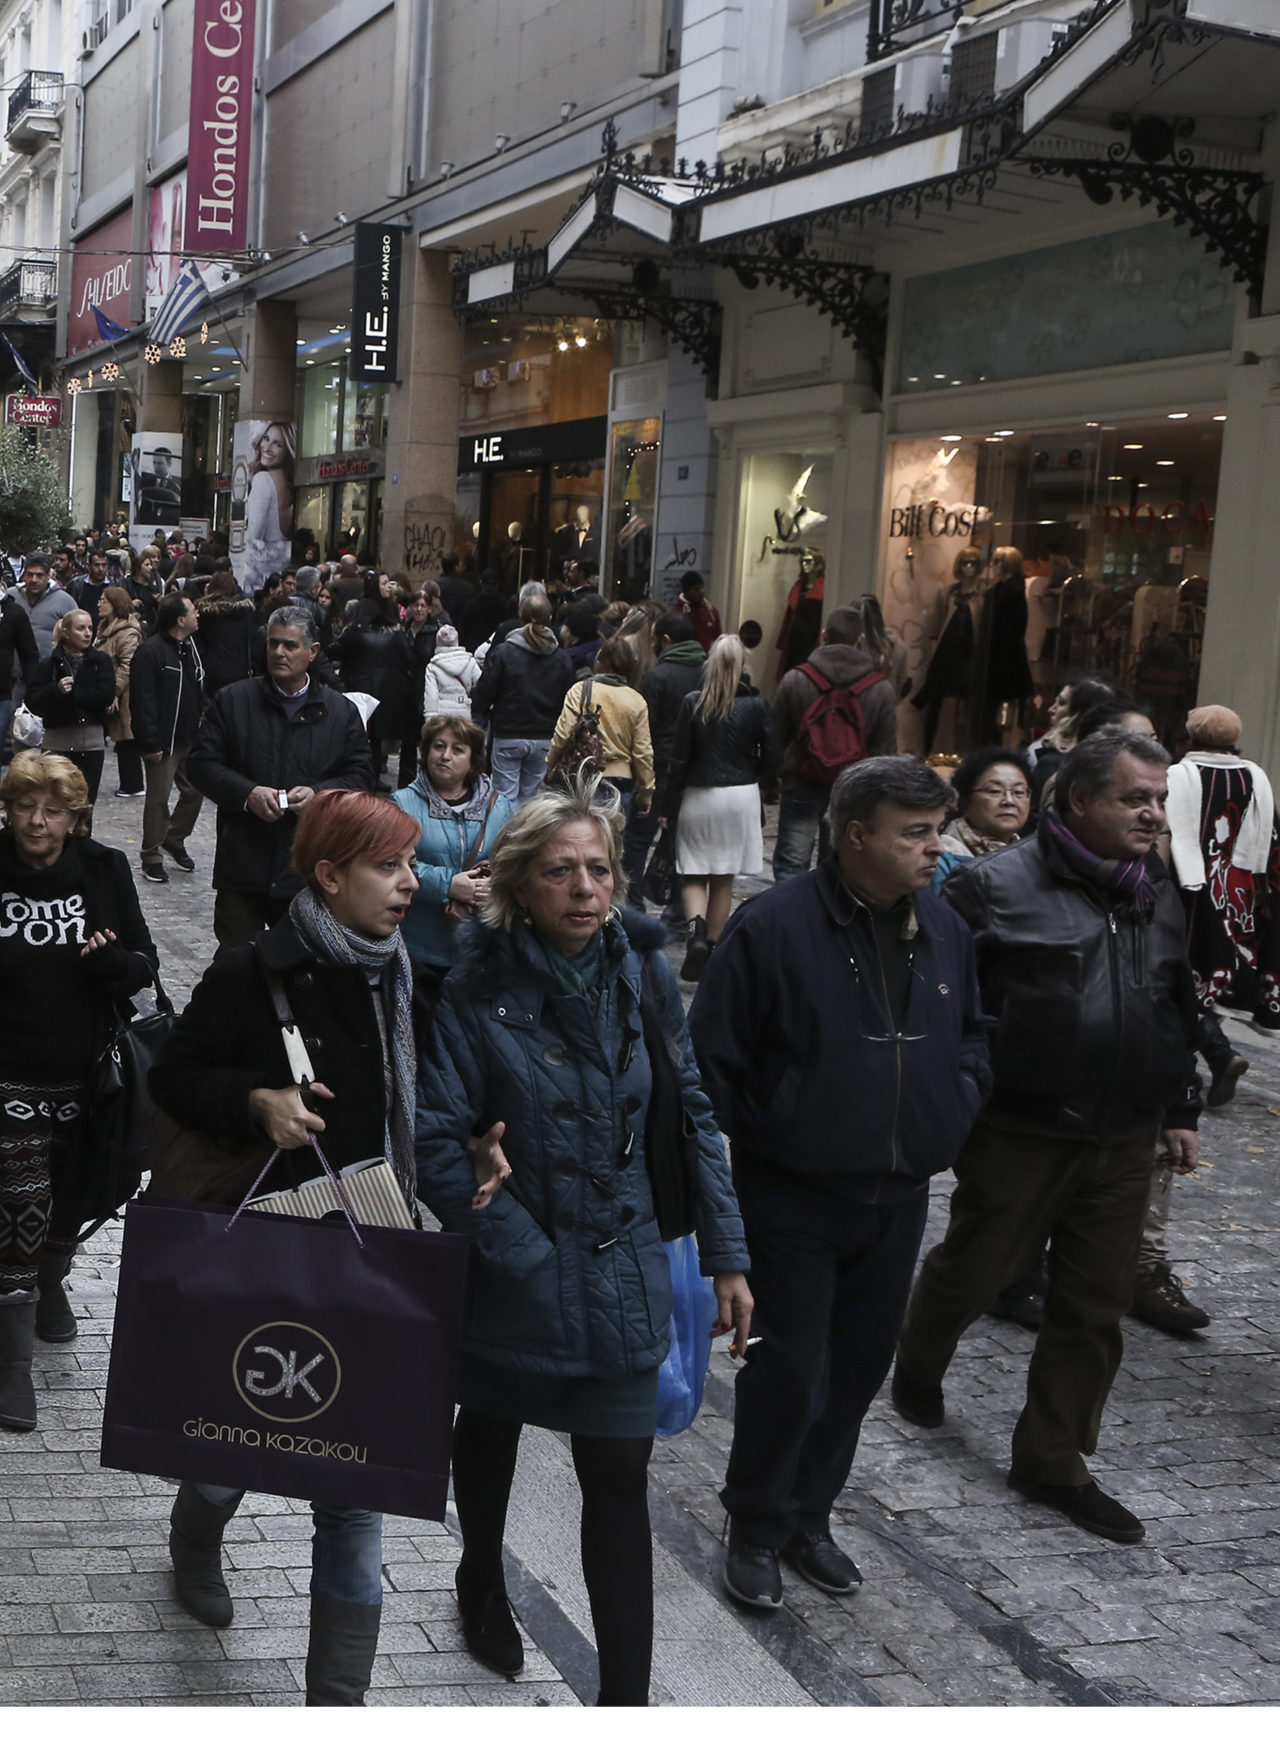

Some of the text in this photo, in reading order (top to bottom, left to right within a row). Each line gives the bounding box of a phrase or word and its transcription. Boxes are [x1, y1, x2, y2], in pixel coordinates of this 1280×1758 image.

[197, 0, 242, 235] Hondos Ce
[381, 235, 391, 281] MANGO
[13, 398, 58, 414] Hondos
[23, 917, 89, 946] on
